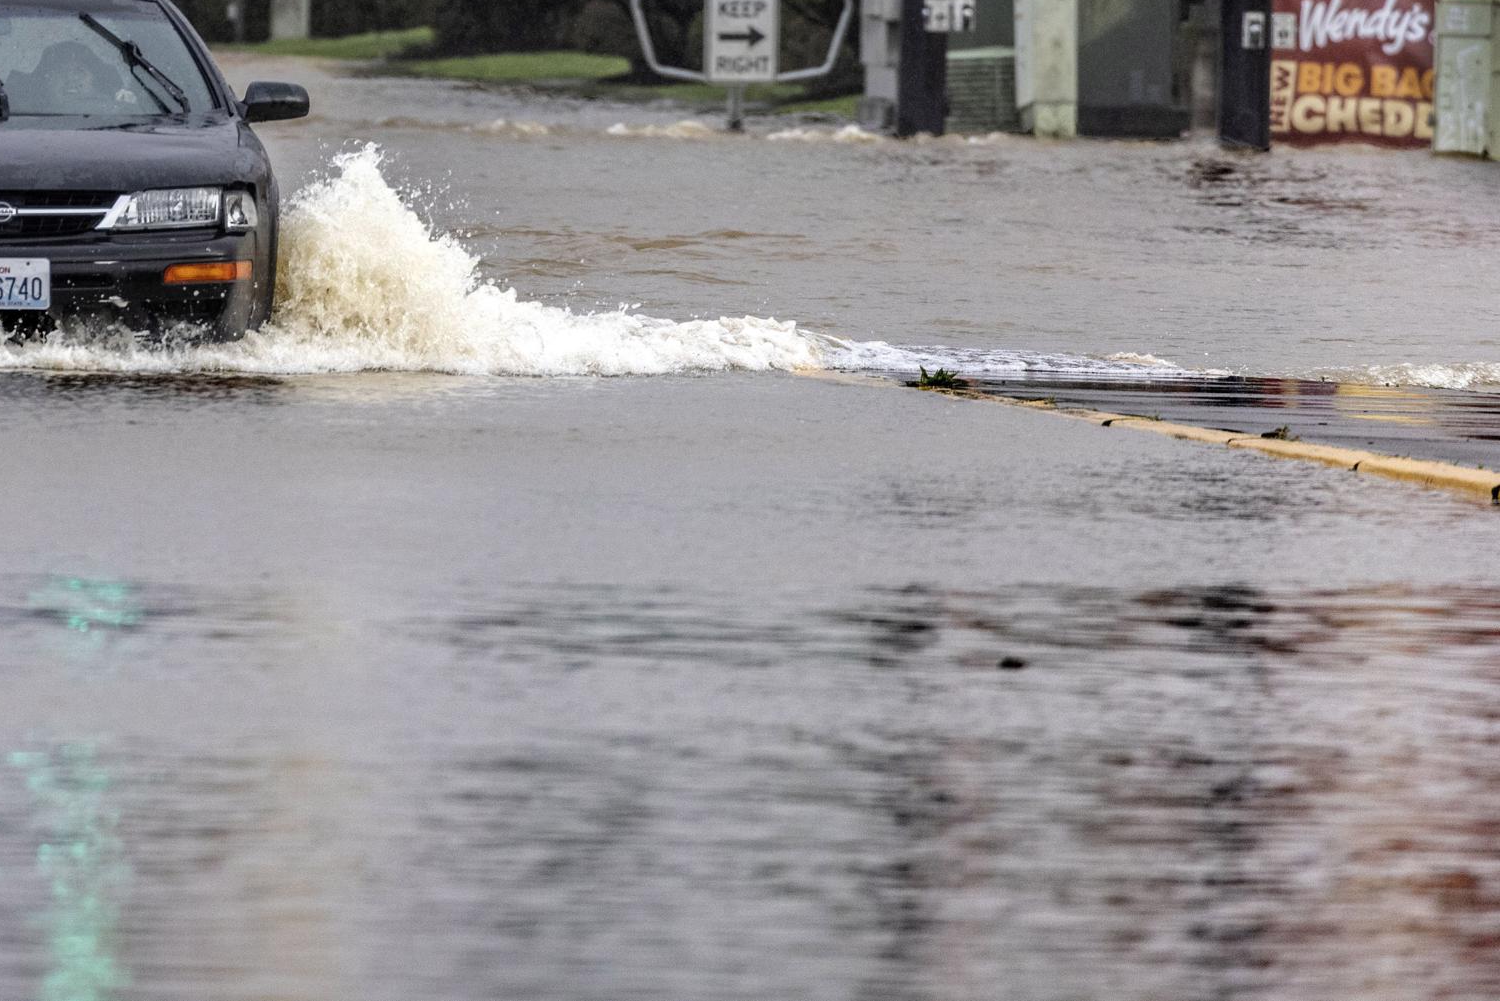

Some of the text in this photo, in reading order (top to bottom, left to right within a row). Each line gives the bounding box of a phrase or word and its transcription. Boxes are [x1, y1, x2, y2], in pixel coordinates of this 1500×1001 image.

[718, 1, 768, 18] KEEP
[715, 56, 770, 73] RIGHT
[1296, 61, 1366, 97] BIG
